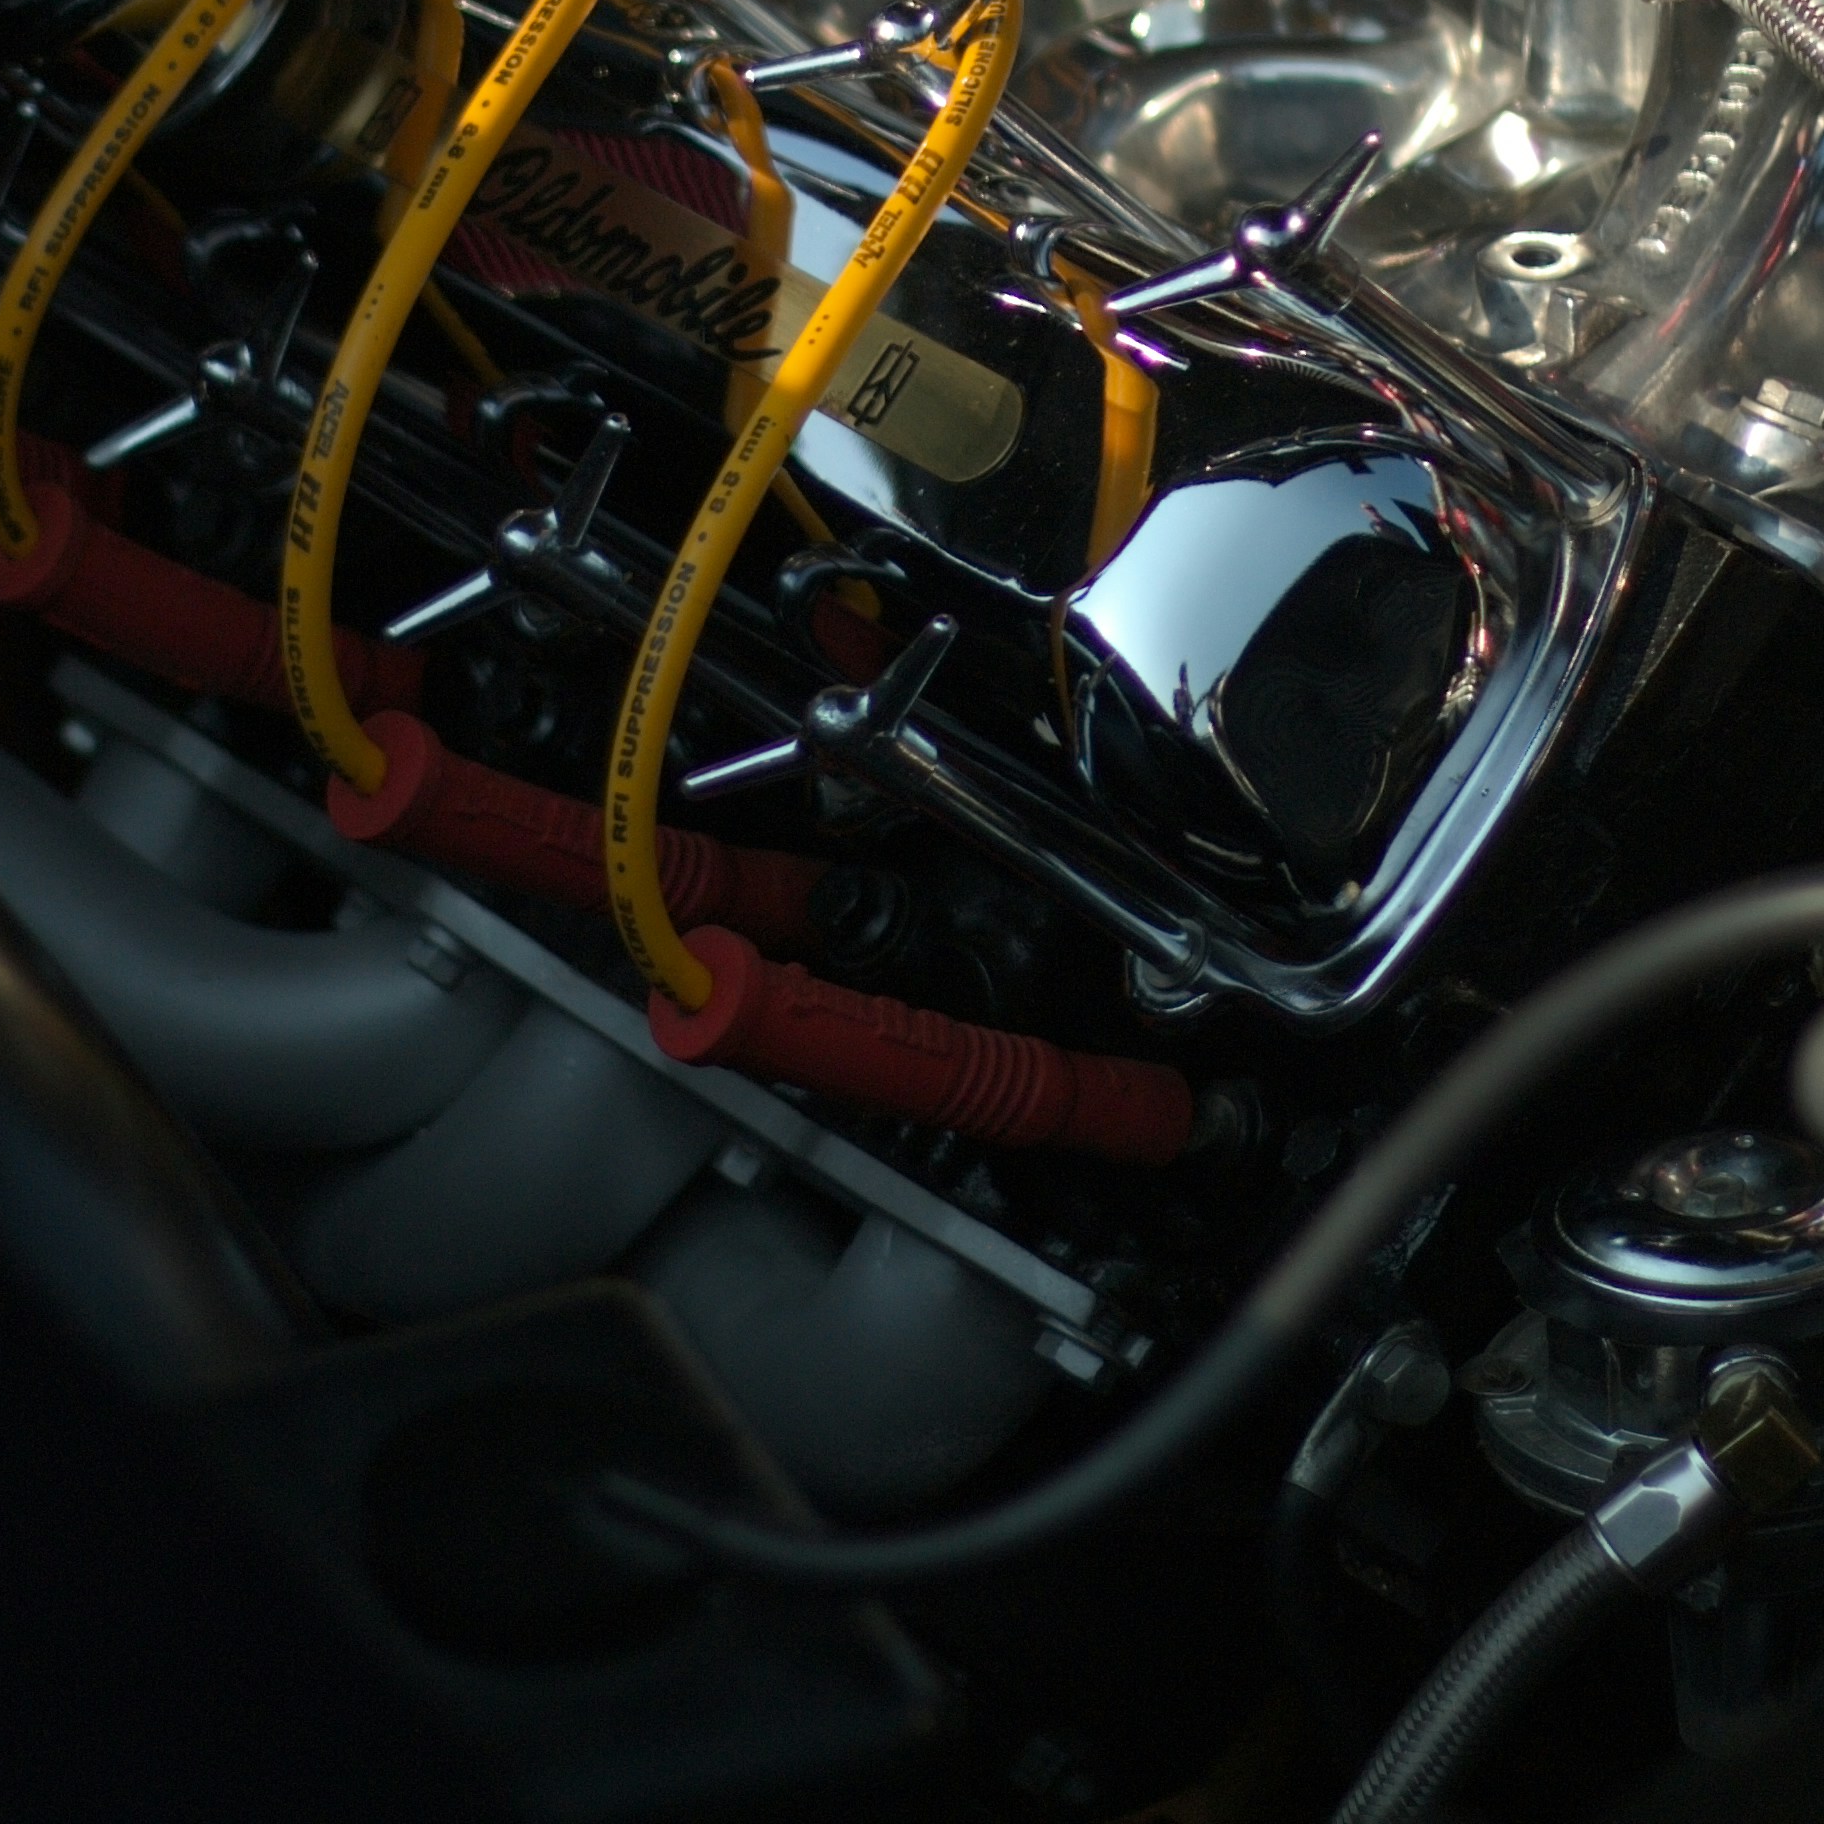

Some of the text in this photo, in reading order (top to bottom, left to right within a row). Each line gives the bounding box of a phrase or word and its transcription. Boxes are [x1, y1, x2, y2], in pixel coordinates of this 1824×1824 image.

[945, 37, 997, 127] SILICONE
[43, 81, 162, 258] SUPPRESSION
[464, 146, 784, 362] Oldsmobile
[708, 469, 741, 514] 8.8
[737, 414, 772, 463] mm
[285, 585, 317, 721] SILICONE
[616, 560, 697, 780] SUPPRESSION
[612, 791, 631, 845] RFI
